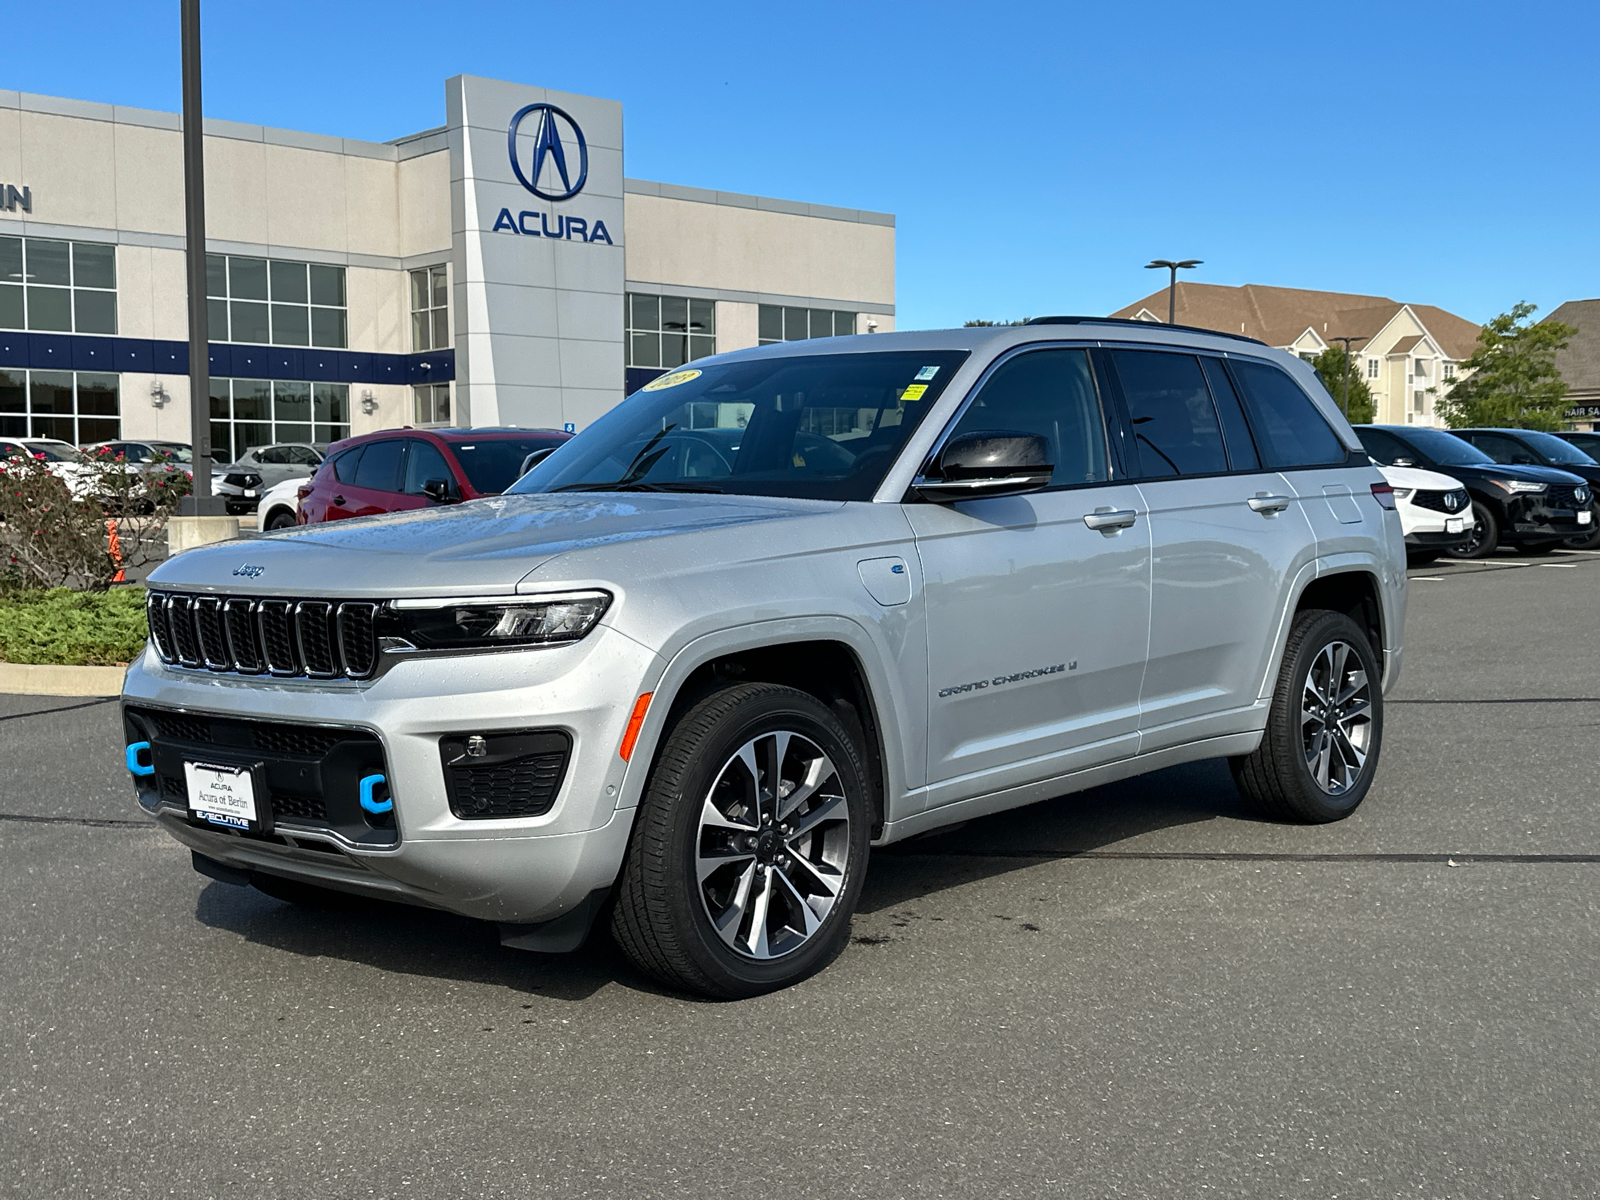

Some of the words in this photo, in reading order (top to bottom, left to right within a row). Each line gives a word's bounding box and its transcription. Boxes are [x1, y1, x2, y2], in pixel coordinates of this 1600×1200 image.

[492, 207, 613, 245] ACURA
[1565, 407, 1586, 417] HAIR
[232, 562, 265, 580] Jeep
[938, 679, 989, 698] GRAND
[992, 663, 1065, 686] CHEROKEE
[210, 782, 233, 792] ACURA
[198, 790, 218, 803] Acura
[219, 794, 226, 805] of
[227, 795, 248, 809] Berlin
